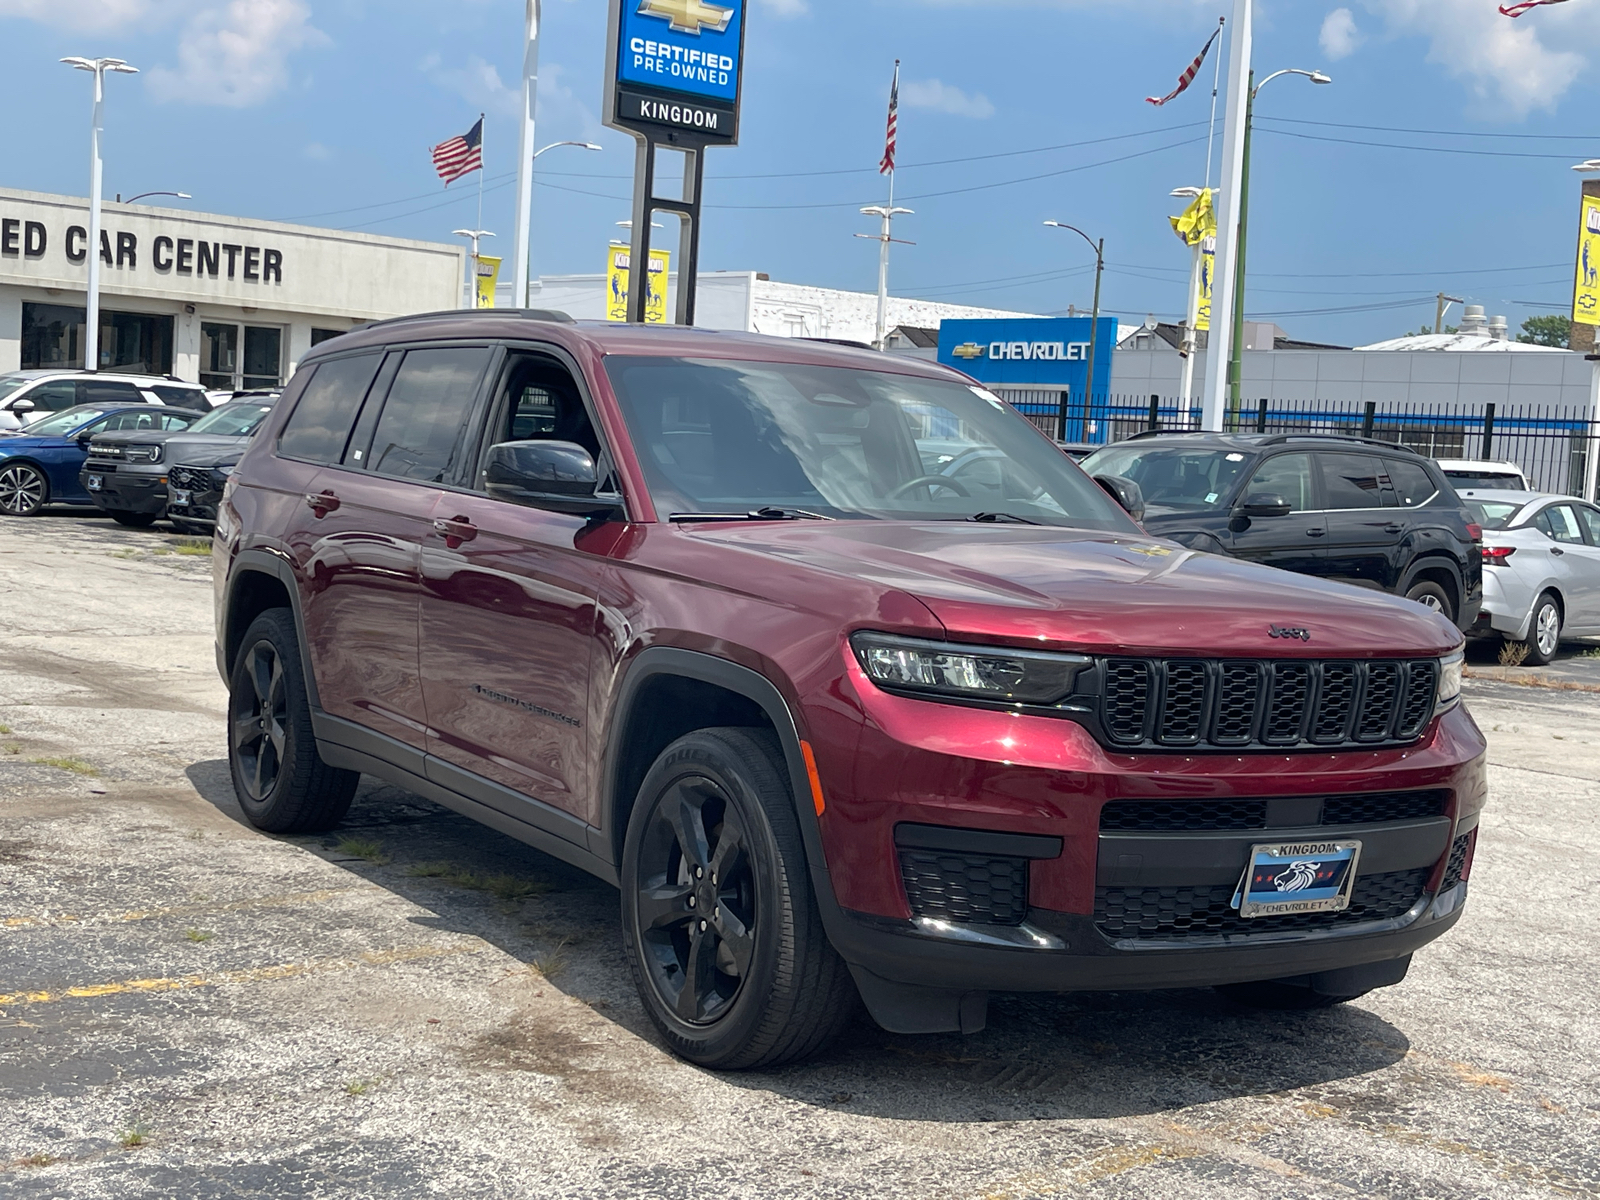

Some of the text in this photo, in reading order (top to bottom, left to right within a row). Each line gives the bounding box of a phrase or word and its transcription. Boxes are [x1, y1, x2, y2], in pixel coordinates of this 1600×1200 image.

[630, 37, 733, 71] CERTIFIED
[633, 55, 728, 86] PRE-OWNED
[640, 100, 718, 129] KINGDOM
[1, 217, 283, 283] ED CAR CENTER
[988, 341, 1091, 361] CHEVROLET
[1266, 623, 1311, 643] Jeep
[1279, 843, 1337, 856] KINGDOM
[1265, 901, 1323, 913] CHEVROLET
